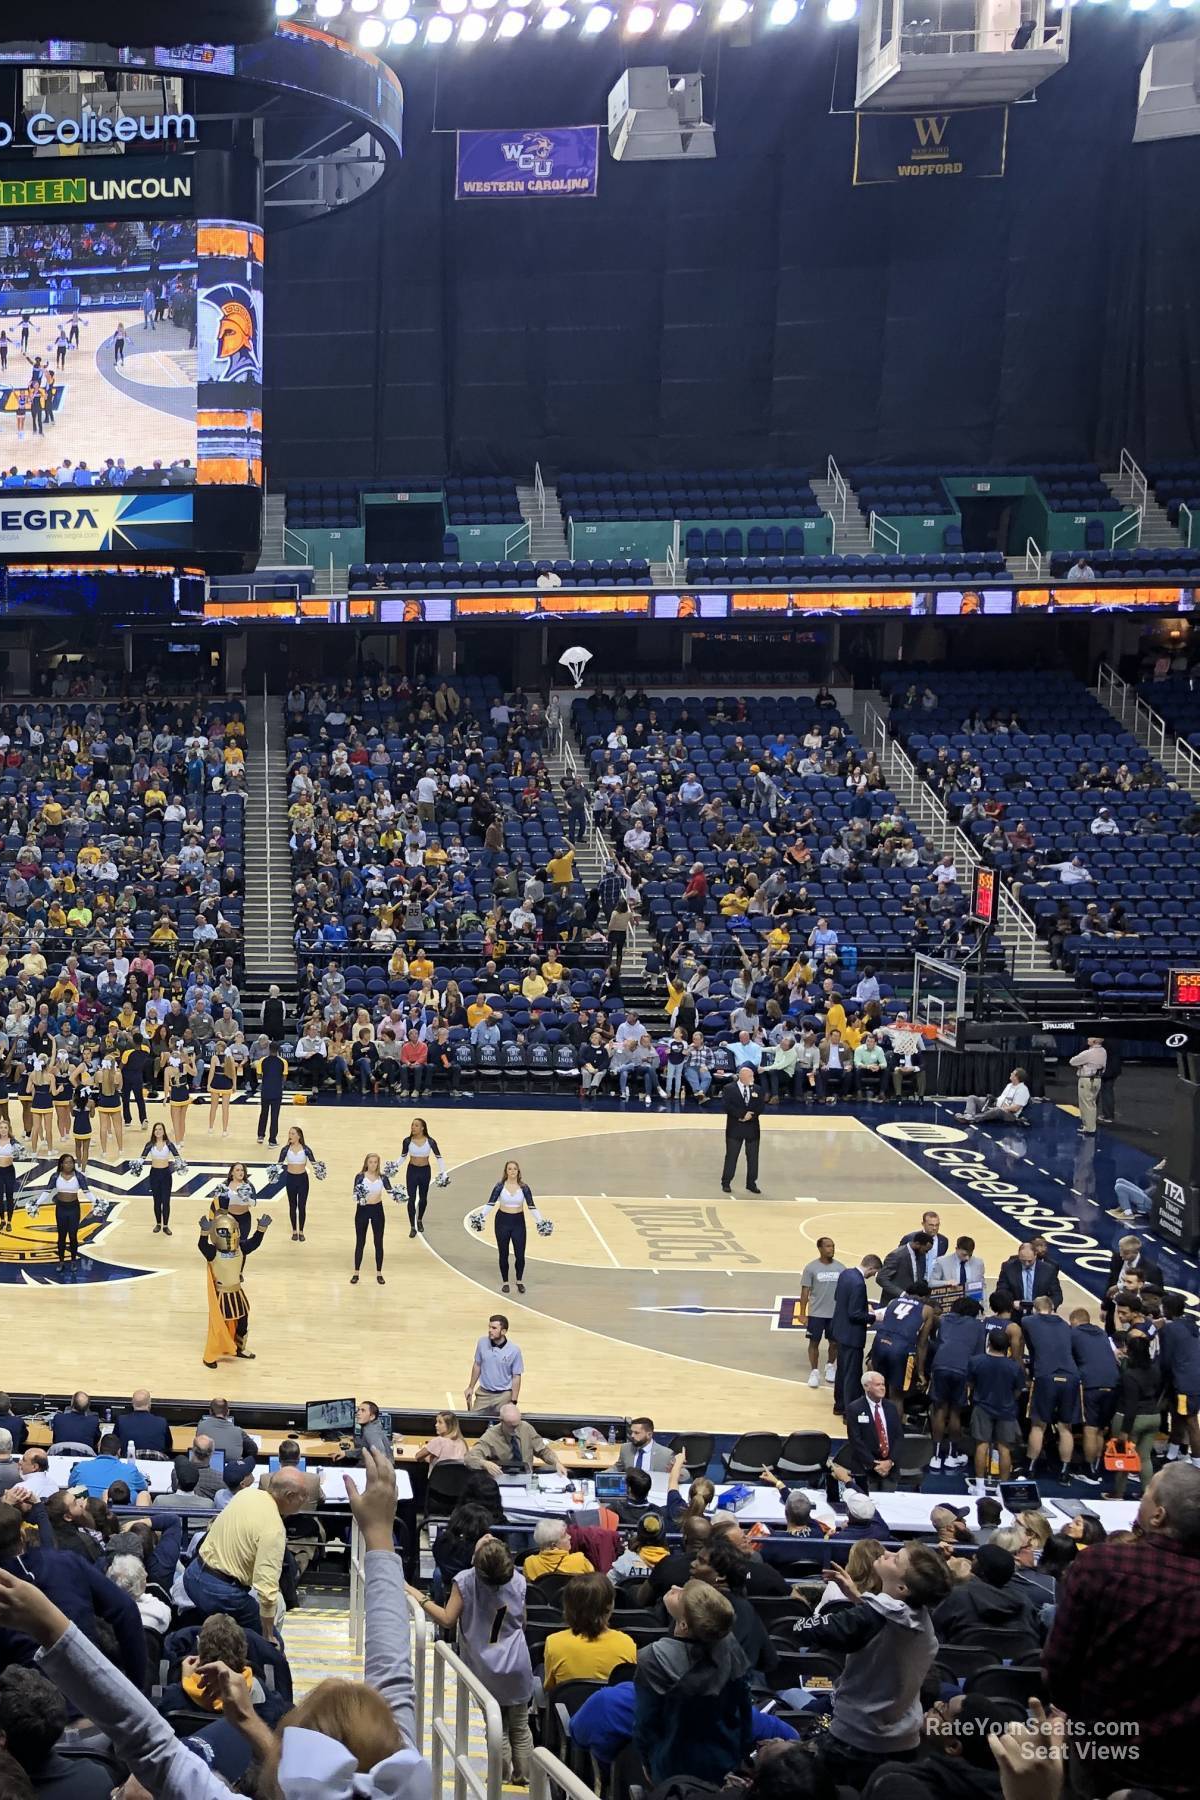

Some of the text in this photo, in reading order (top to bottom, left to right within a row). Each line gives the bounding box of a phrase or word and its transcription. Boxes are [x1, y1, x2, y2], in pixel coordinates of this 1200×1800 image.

[26, 111, 196, 147] Coliseum
[913, 117, 951, 146] W
[898, 162, 963, 176] WOFFORD
[90, 176, 191, 202] LINCOLN
[464, 178, 589, 192] WESTERN CAROLINA
[1178, 987, 1199, 1002] 30
[1041, 1022, 1075, 1031] SPALDING
[1162, 1178, 1186, 1205] TFA
[893, 1302, 914, 1320] 4
